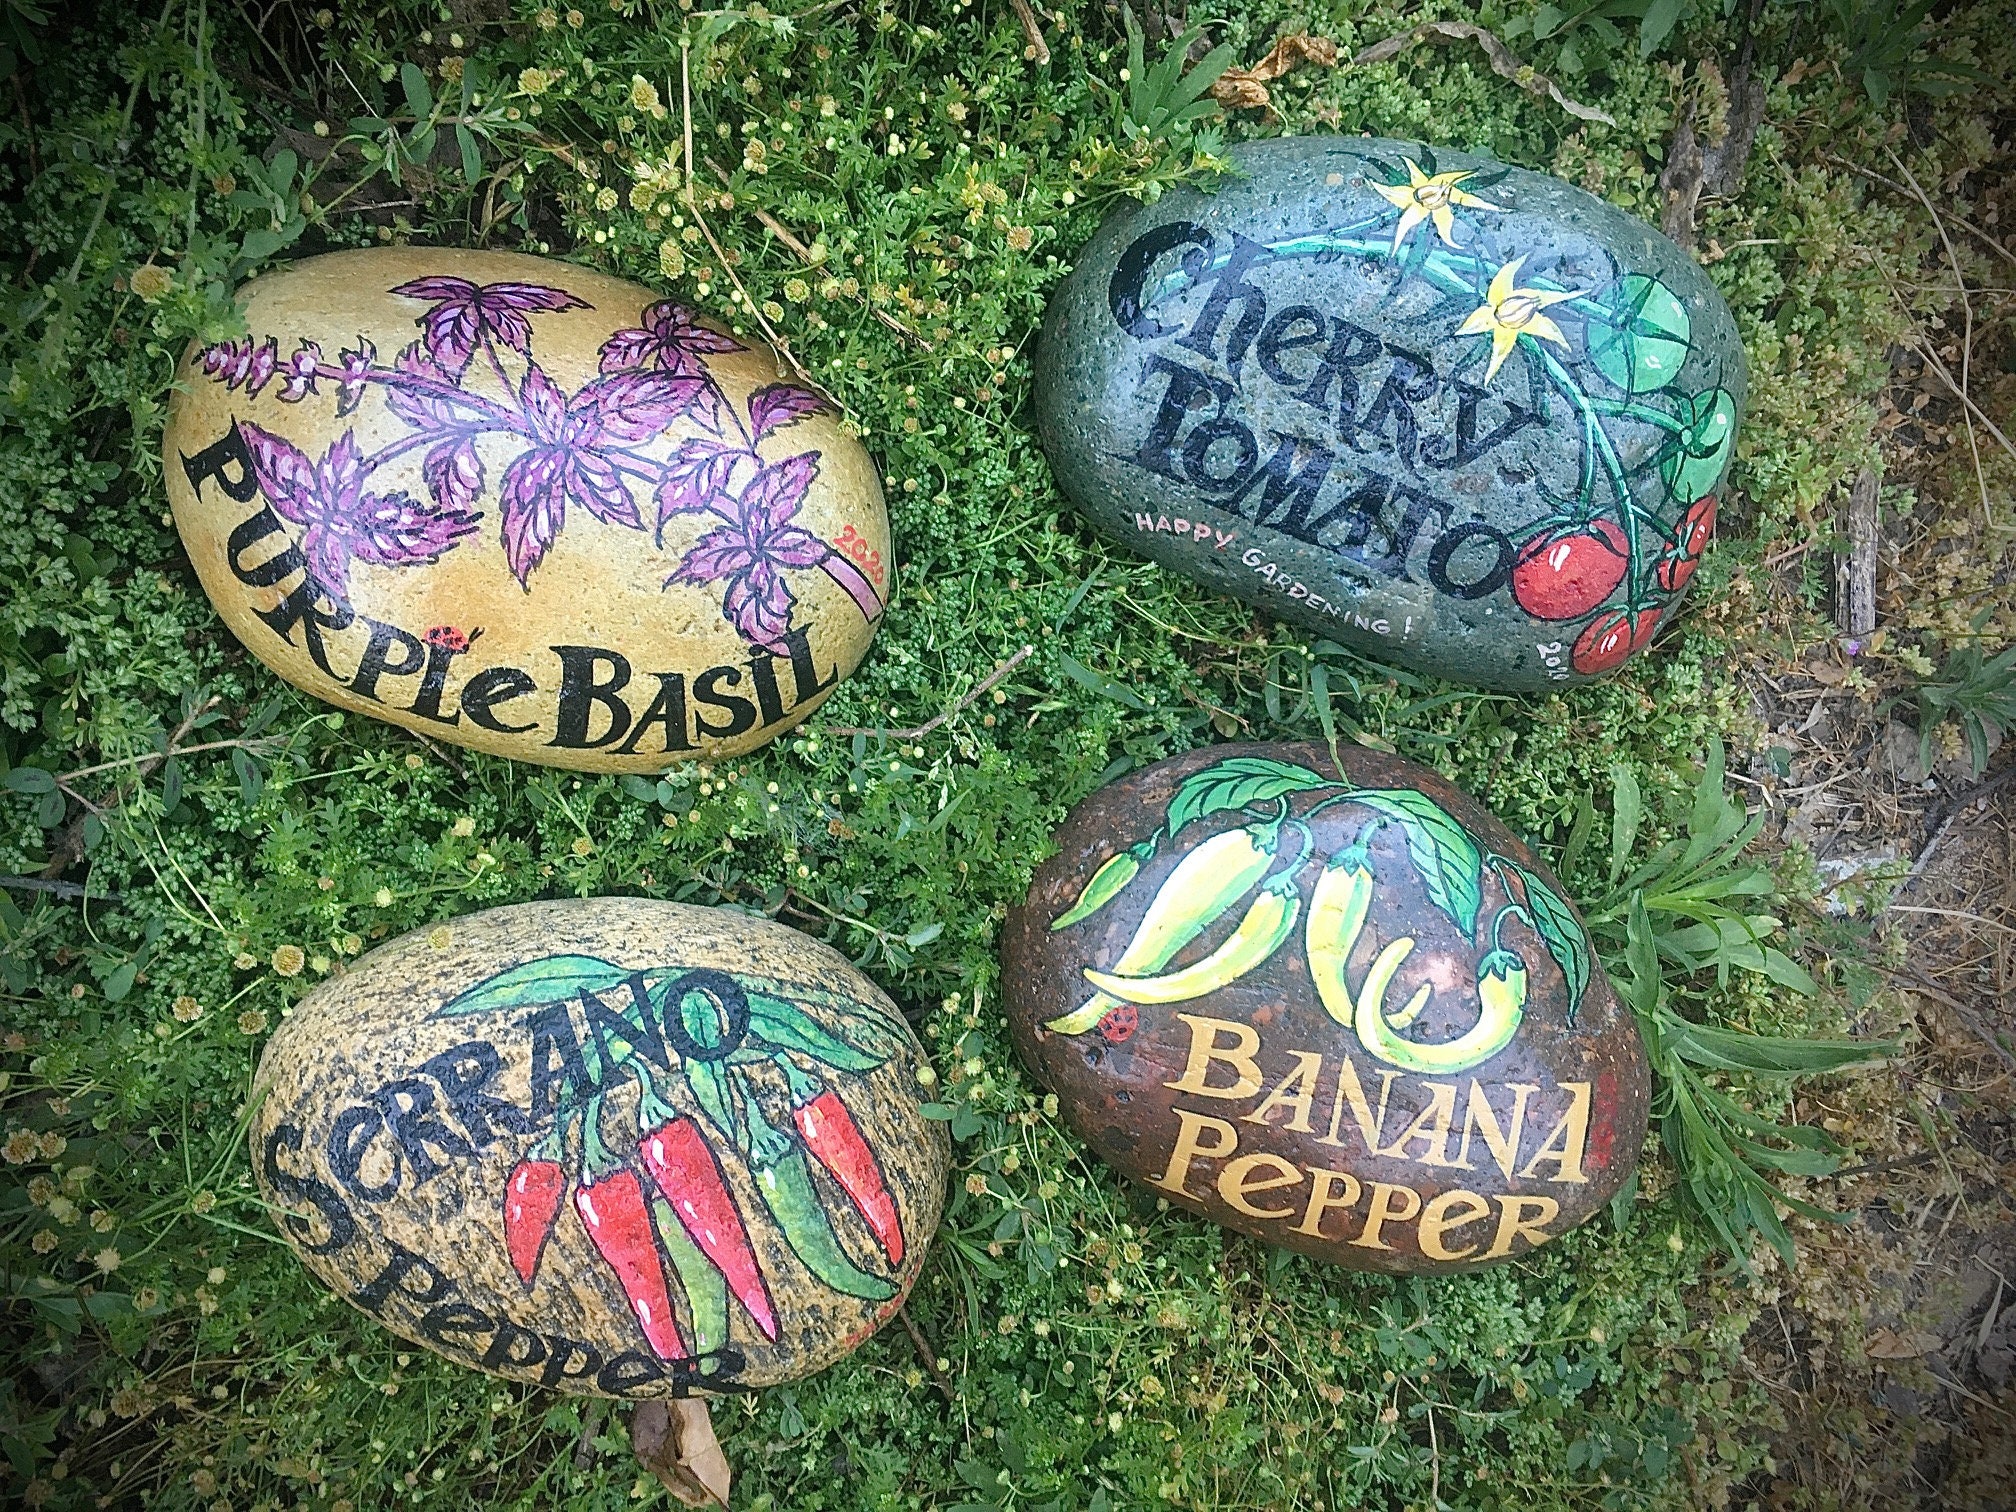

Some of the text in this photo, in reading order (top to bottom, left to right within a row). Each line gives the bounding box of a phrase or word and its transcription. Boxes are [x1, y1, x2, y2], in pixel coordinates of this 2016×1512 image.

[1103, 353, 1517, 599] TOMATO
[833, 524, 884, 585] 2020
[1135, 512, 1236, 550] HAPPY
[1242, 548, 1391, 635] GARDENING
[1163, 1013, 1592, 1183] BANANA
